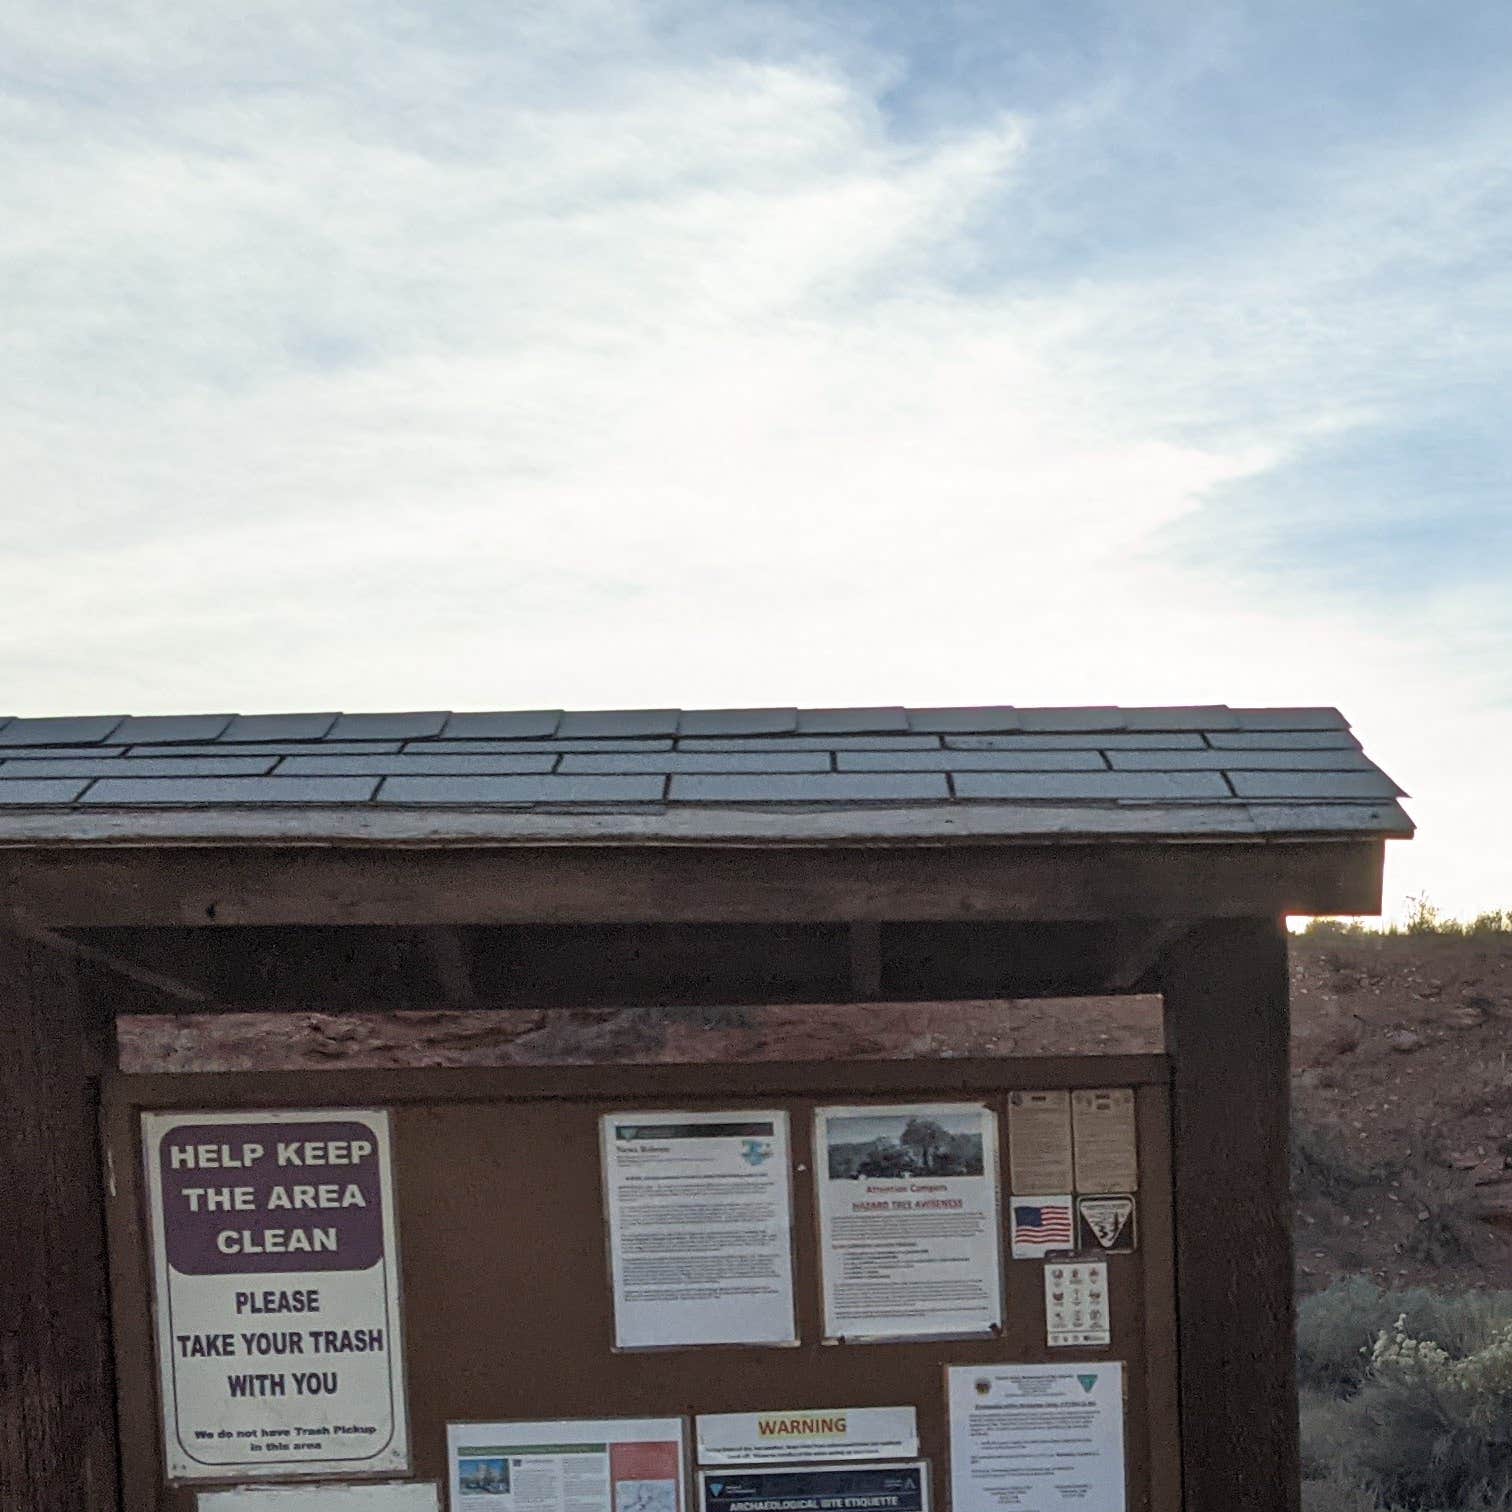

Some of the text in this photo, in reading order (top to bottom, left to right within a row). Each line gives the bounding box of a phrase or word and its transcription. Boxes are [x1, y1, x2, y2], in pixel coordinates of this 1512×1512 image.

[170, 1141, 372, 1169] HELP KEEP
[182, 1185, 366, 1211] THE AREA
[217, 1228, 337, 1254] CLEAN
[235, 1290, 320, 1314] PLEASE
[177, 1329, 383, 1357] TAKE YOUR TRASH
[228, 1372, 337, 1397] WITH YOU
[195, 1425, 376, 1440] We do not have Trash Pickup
[759, 1418, 847, 1435] WARNING
[251, 1441, 321, 1451] in this area
